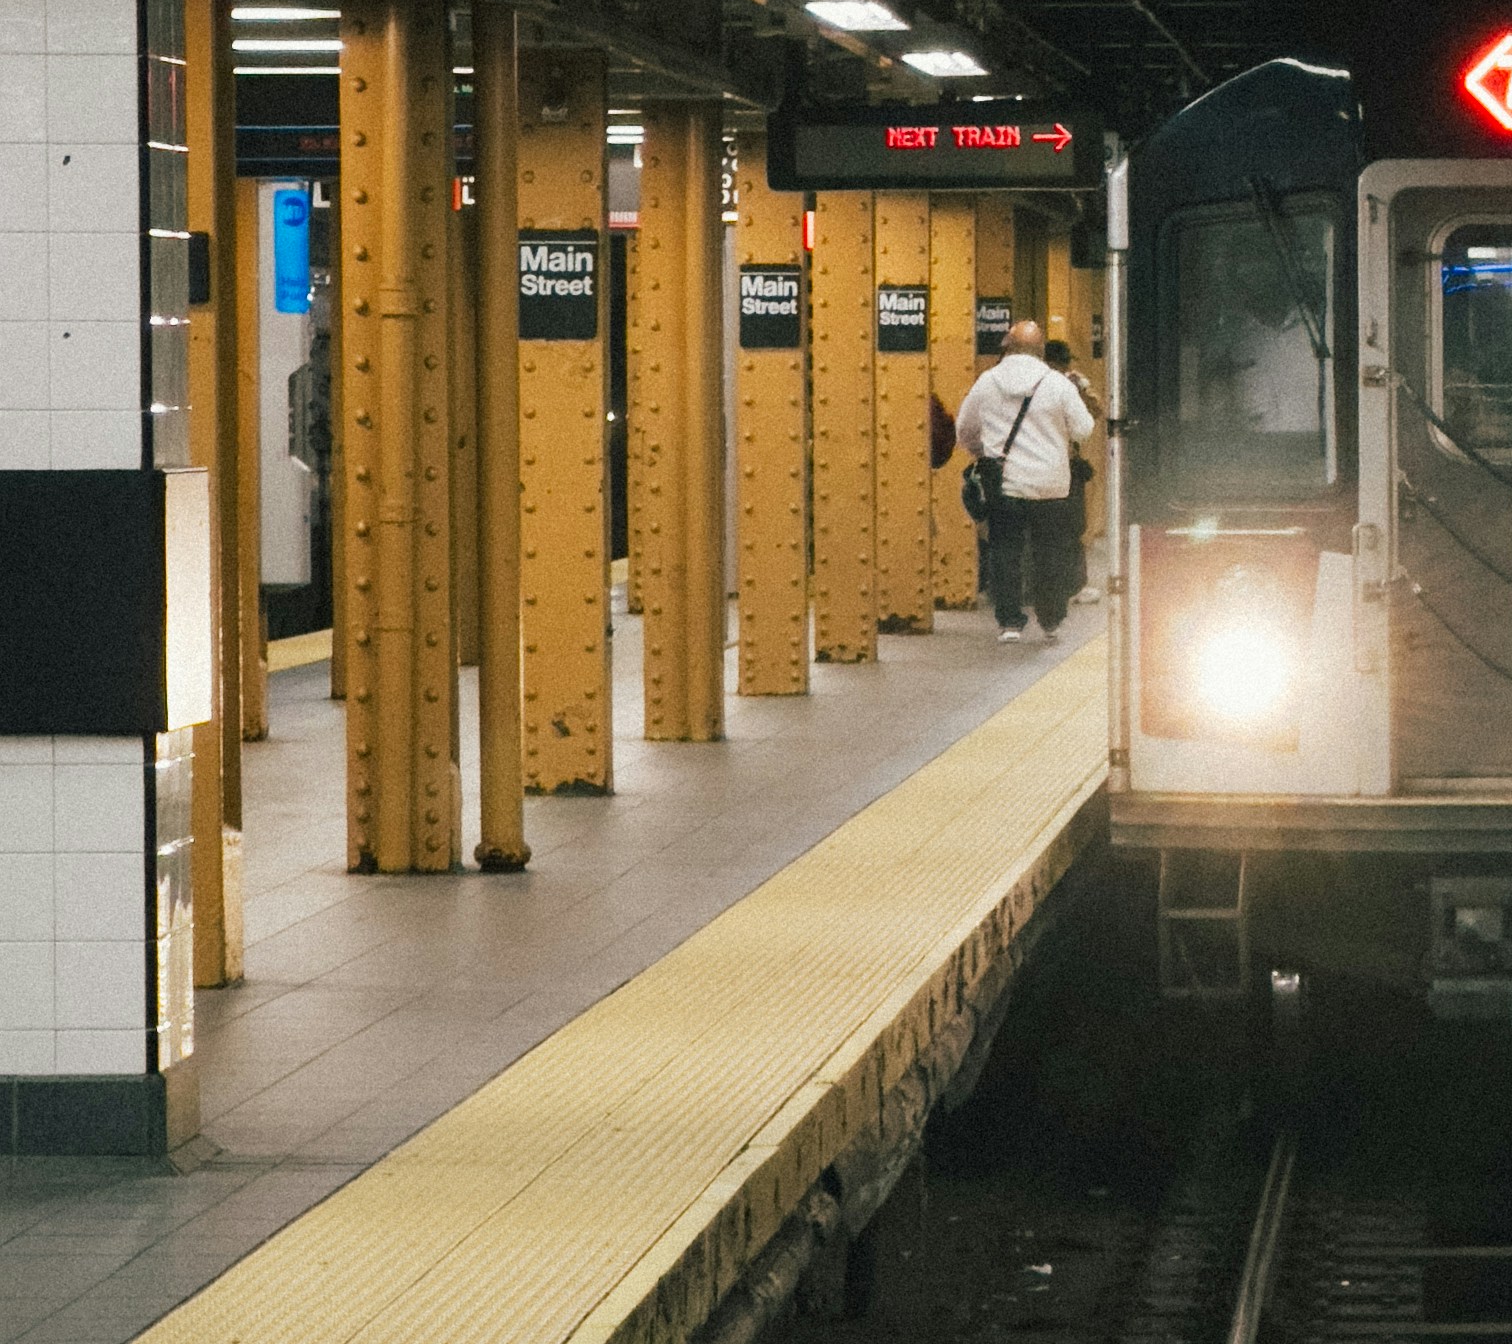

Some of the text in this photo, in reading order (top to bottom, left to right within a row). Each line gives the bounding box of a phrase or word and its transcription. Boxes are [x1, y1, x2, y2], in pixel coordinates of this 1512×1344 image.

[886, 125, 1021, 148] NEXT TRAIN
[520, 245, 593, 272] Main
[521, 273, 594, 296] Street
[741, 275, 798, 297] Main
[741, 297, 798, 315] Street
[879, 293, 925, 311] Main
[879, 311, 925, 326] Street
